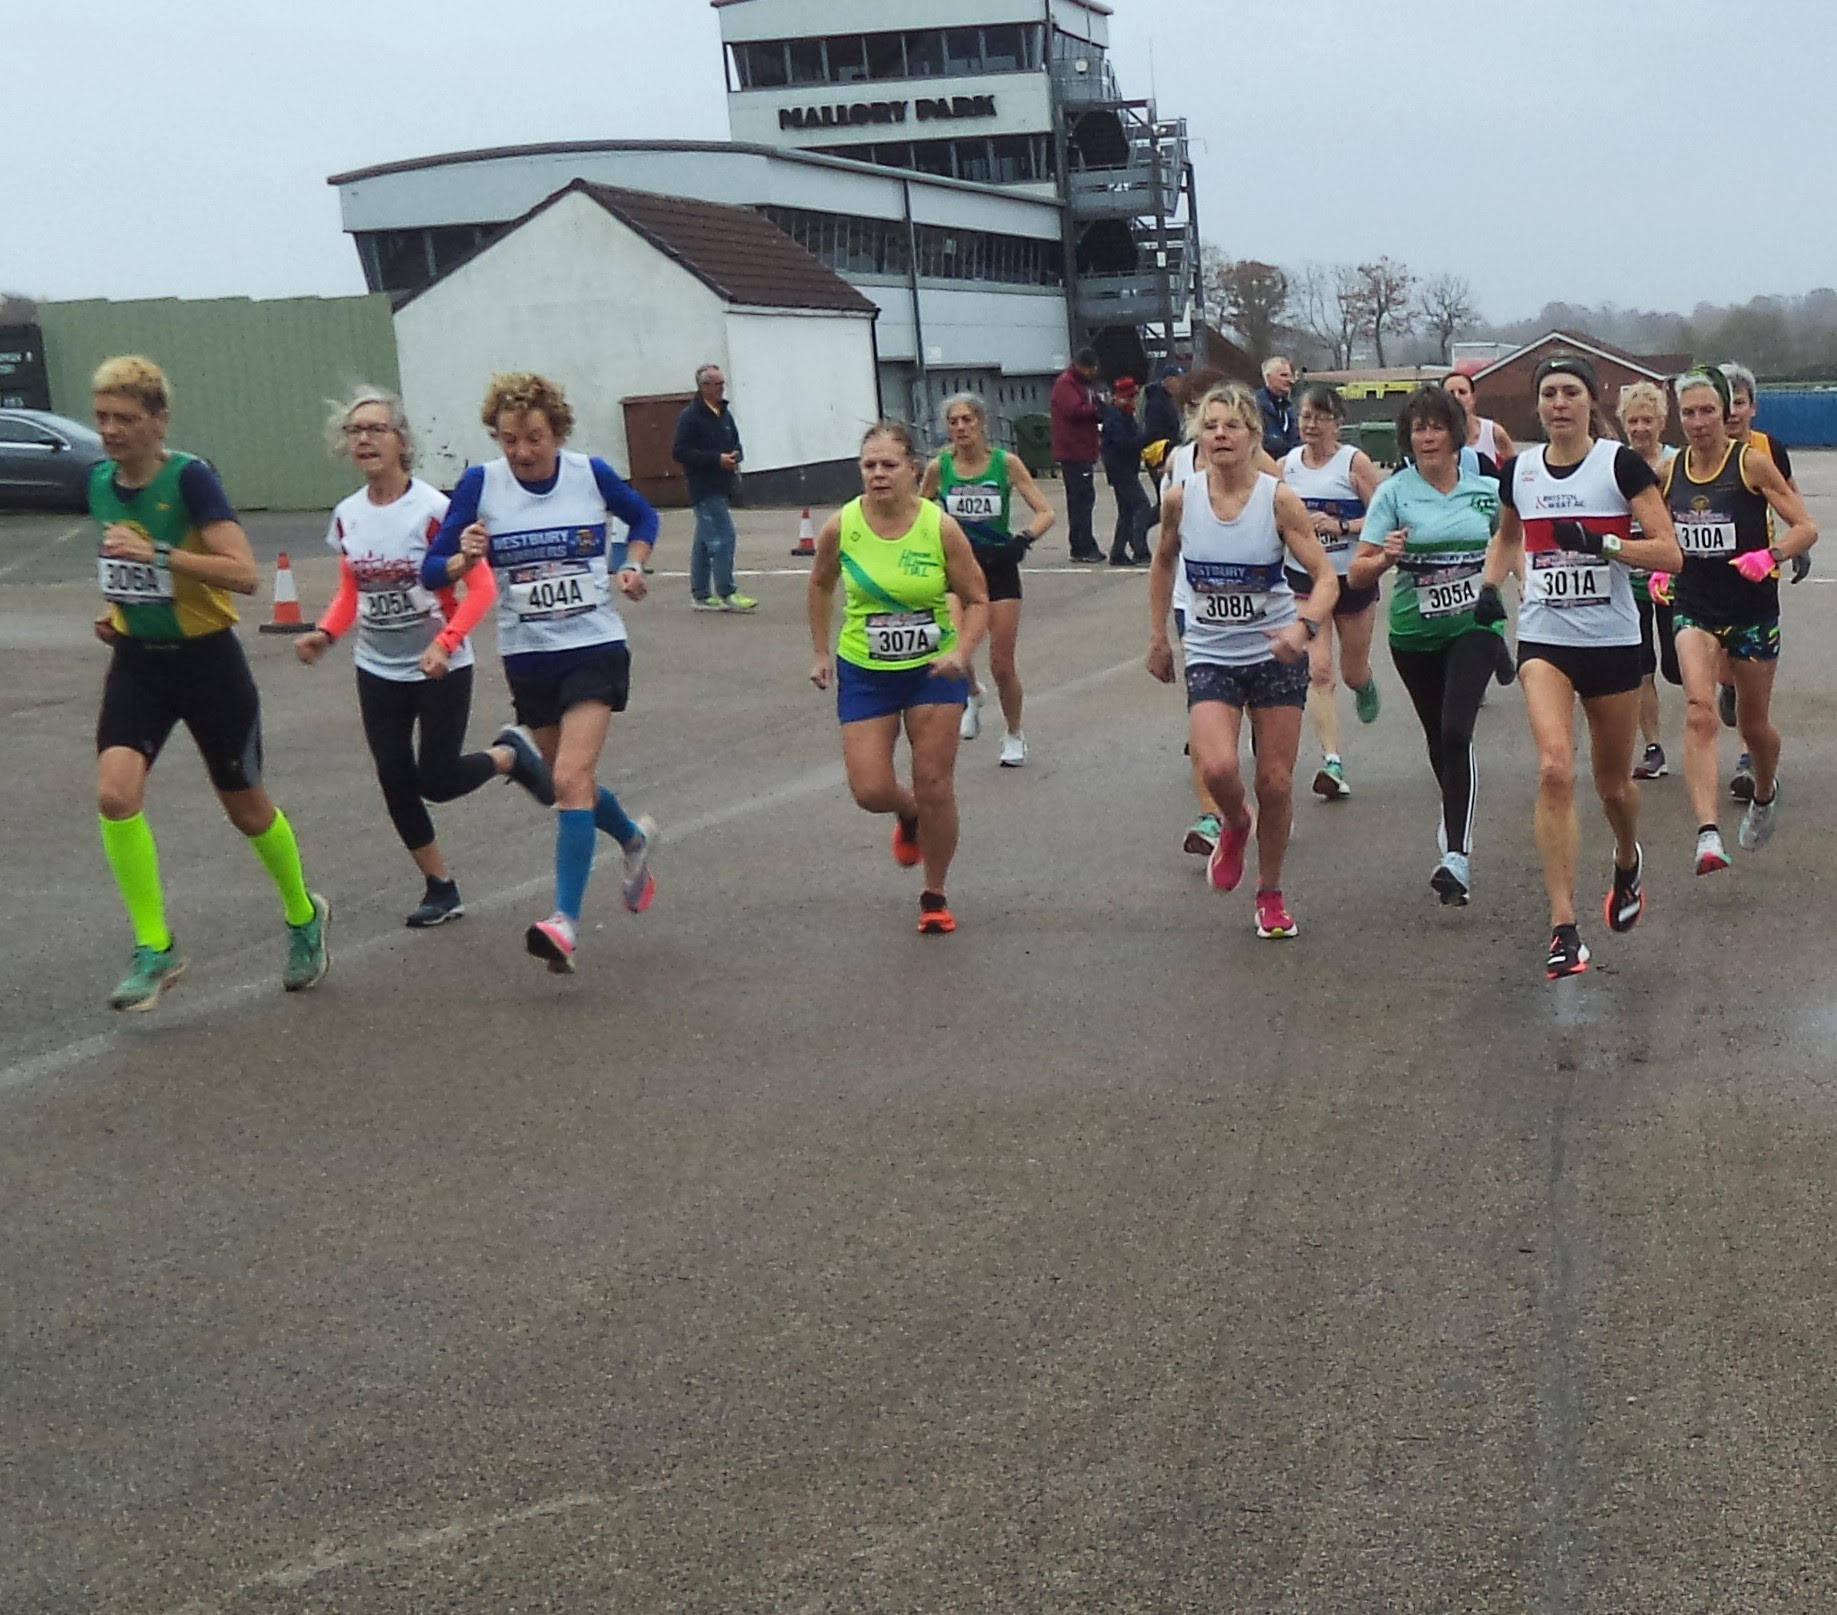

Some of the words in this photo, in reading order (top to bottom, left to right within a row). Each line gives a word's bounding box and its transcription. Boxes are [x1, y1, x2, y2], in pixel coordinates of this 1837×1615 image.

[779, 100, 908, 130] MALLORY
[915, 95, 997, 121] PARK
[956, 497, 993, 514] 402A
[1682, 527, 1724, 548] 310A
[529, 579, 584, 609] 404A
[1428, 580, 1476, 609] 305A
[1543, 569, 1597, 596] 301A
[1206, 595, 1255, 618] 308A
[879, 628, 929, 652] 307A
